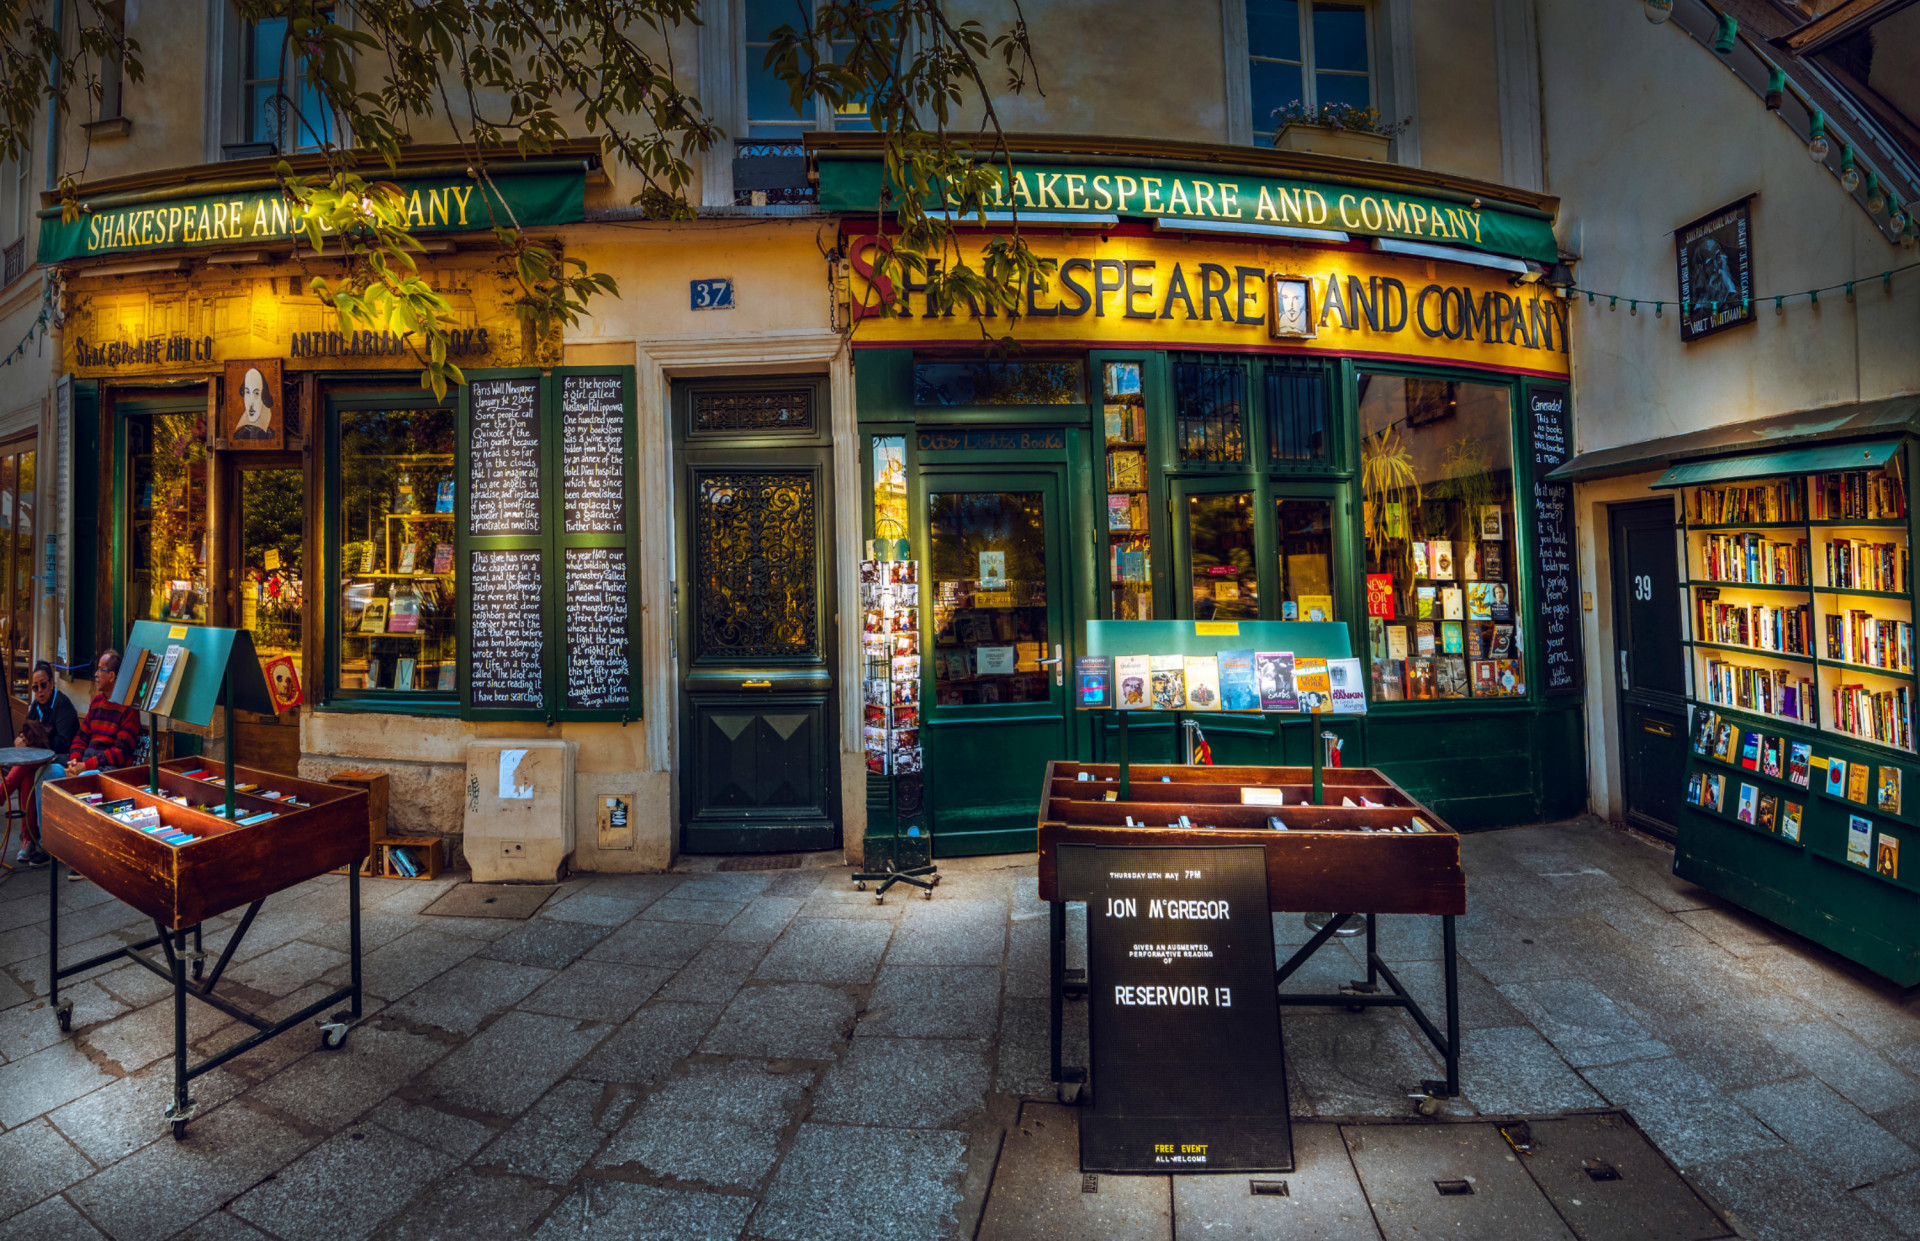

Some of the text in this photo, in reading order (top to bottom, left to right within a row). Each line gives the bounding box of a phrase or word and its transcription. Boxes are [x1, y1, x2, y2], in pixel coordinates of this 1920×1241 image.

[1255, 185, 1327, 225] AND
[1339, 194, 1482, 243] COMPANY
[88, 200, 244, 251] SHAKESPEARE
[697, 283, 726, 306] 37
[850, 235, 1569, 353] SHESPEARE AND COMPANY
[426, 328, 489, 355] OKS
[166, 337, 191, 362] AND
[473, 384, 490, 396] Paris
[491, 381, 505, 394] Wall
[564, 377, 621, 389] for the heroine
[570, 389, 587, 403] girl
[588, 388, 616, 399] called
[475, 408, 533, 421] Some people call
[564, 415, 623, 426] One hundred years
[1534, 414, 1557, 424] This is
[1536, 453, 1541, 463] a
[1540, 536, 1551, 546] you
[472, 552, 488, 563] This
[505, 552, 518, 561] has
[1555, 546, 1566, 558] who
[1367, 579, 1386, 590] NEW
[1547, 576, 1568, 593] spring
[1635, 575, 1652, 601] 39
[1546, 588, 1563, 603] from
[473, 601, 539, 612] than my next door
[1541, 602, 1570, 620] the pages
[472, 611, 540, 623] neighbors and even
[1548, 621, 1564, 634] into
[567, 636, 575, 644] to
[576, 634, 593, 648] light
[596, 635, 607, 644] the
[1547, 637, 1565, 653] your
[569, 677, 585, 686] Now
[608, 678, 621, 687] my
[1333, 692, 1363, 700] RANKIN
[1165, 872, 1179, 881] MAY
[1185, 870, 1201, 879] 7PM
[1106, 898, 1137, 918] JON
[1115, 986, 1231, 1007] RESERVOIR 13
[1154, 1145, 1208, 1155] FREE EVENT
